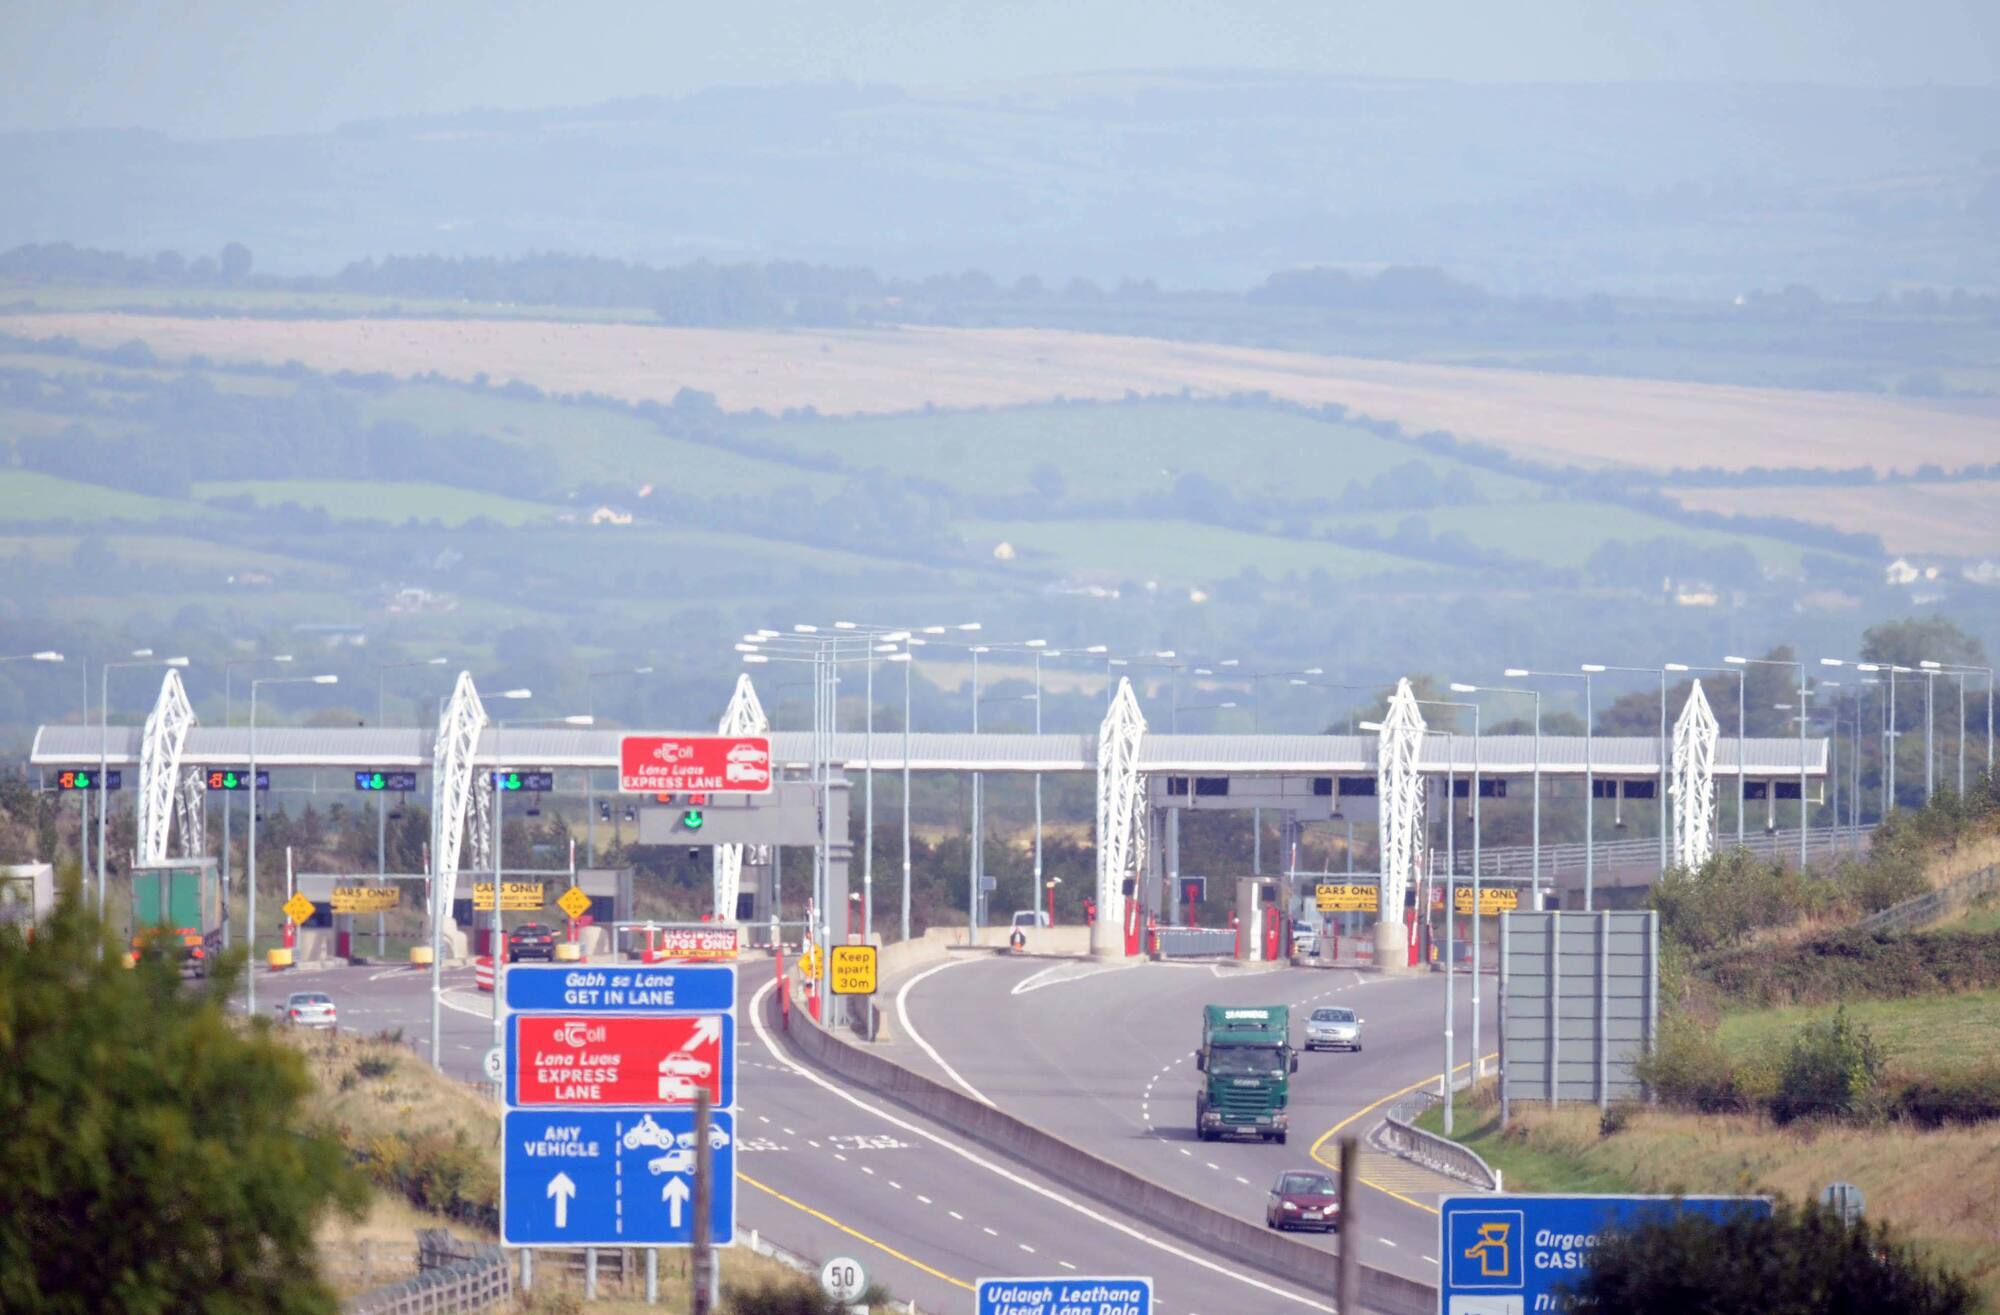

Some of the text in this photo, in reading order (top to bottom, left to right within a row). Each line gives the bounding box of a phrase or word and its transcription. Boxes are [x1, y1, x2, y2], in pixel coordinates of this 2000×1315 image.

[623, 776, 724, 788] EXPRESS LANE
[510, 883, 539, 894] ONLY
[1317, 886, 1346, 895] CARS
[1456, 888, 1519, 899] CAS ONLY
[701, 939, 735, 950] ONLY
[840, 952, 870, 964] Keep
[837, 965, 869, 975] apart
[565, 972, 606, 988] Gabh
[611, 975, 630, 988] sa
[840, 977, 869, 989] 30m
[564, 990, 675, 1005] GET IN LANE
[491, 1053, 501, 1071] 5
[537, 1068, 619, 1083] EXPRESS
[555, 1085, 602, 1100] LANE
[544, 1126, 582, 1141] ANY
[524, 1141, 600, 1157] VEHICLE
[831, 1266, 854, 1287] 50
[987, 1286, 1141, 1305] Ualaigh Leathana
